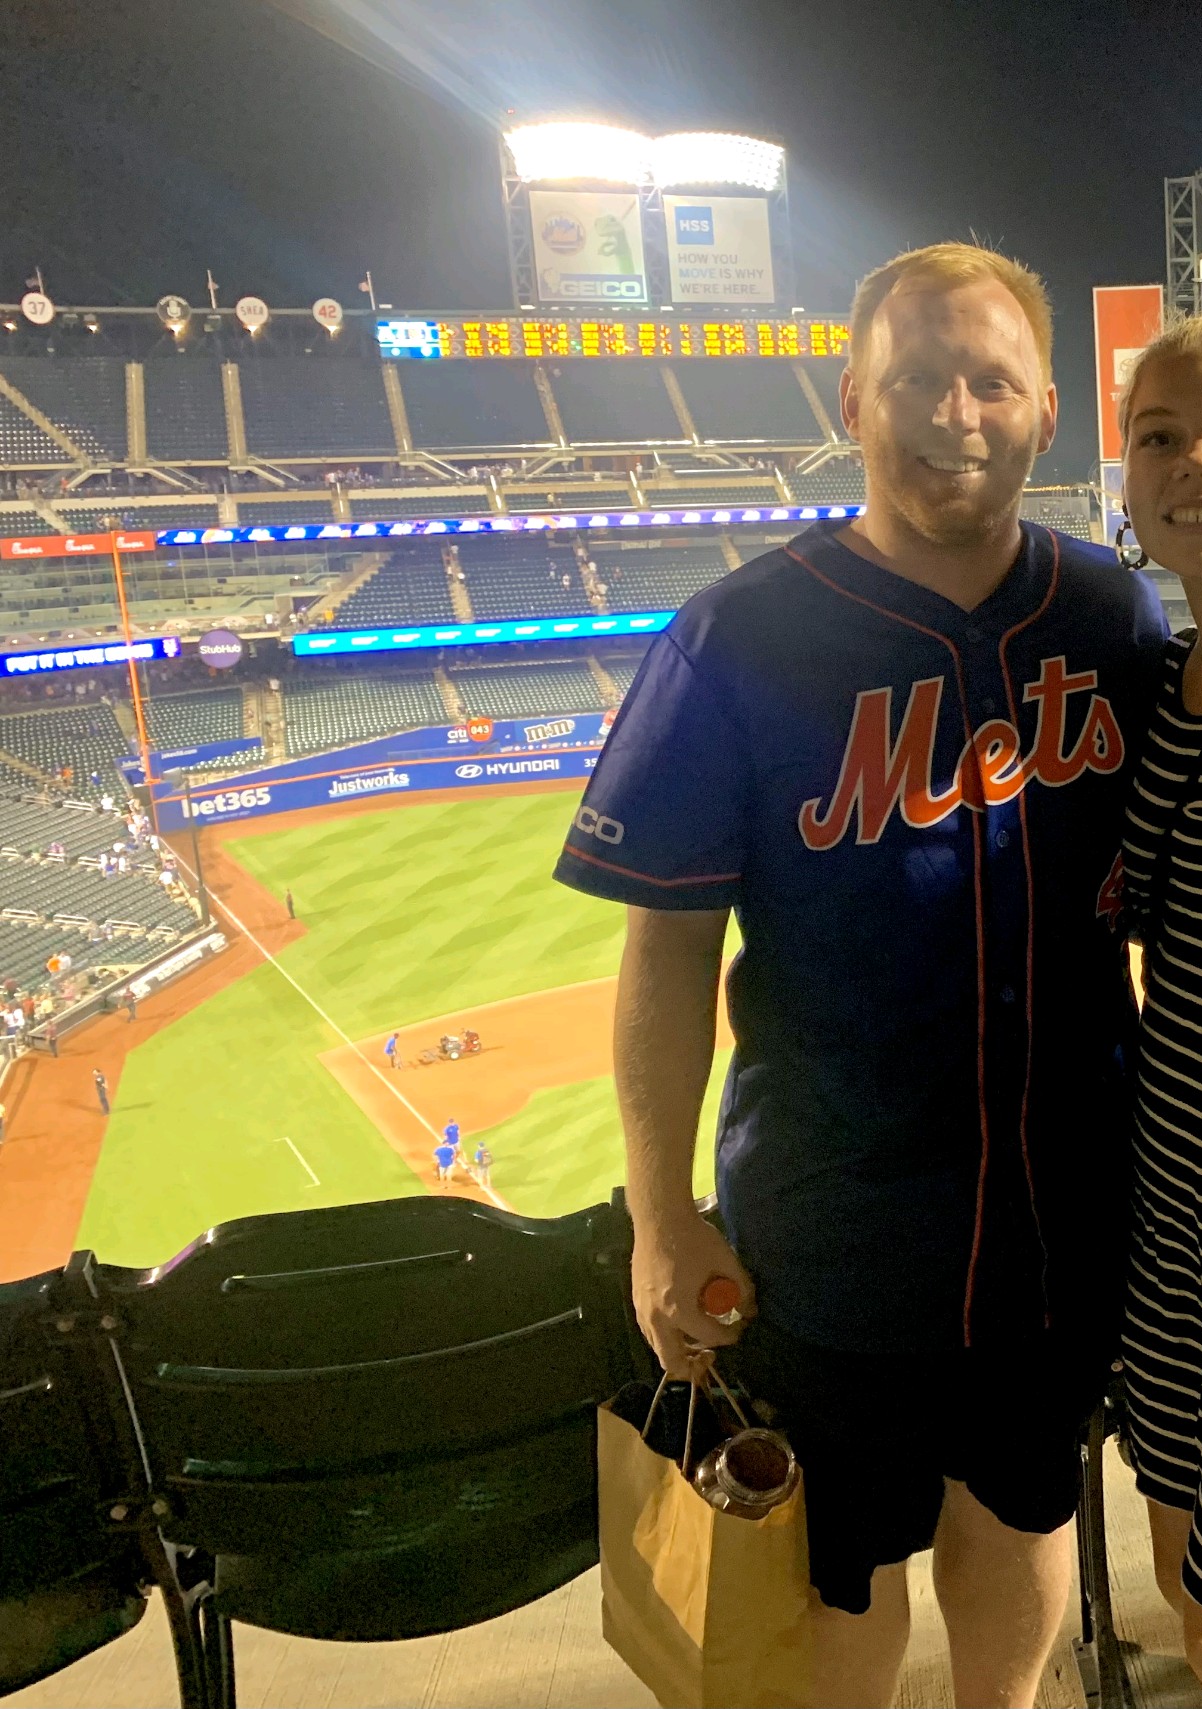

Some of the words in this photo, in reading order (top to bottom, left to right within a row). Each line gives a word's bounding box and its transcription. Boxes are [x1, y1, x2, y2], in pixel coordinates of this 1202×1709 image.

[679, 219, 710, 233] HSS
[678, 253, 708, 265] HOW
[711, 254, 738, 265] YOU
[679, 268, 716, 279] MOVE
[719, 268, 732, 279] IS
[735, 268, 764, 279] WHY
[560, 280, 641, 297] GEICO
[680, 283, 720, 295] WE'RE
[28, 301, 46, 316] 37
[240, 305, 264, 316] SHEA
[317, 306, 337, 319] 42
[200, 643, 242, 655] StubHub
[798, 655, 1125, 851] Mets
[486, 758, 560, 776] HYUNDAI
[328, 771, 410, 795] Justworks
[181, 786, 271, 818] bet365
